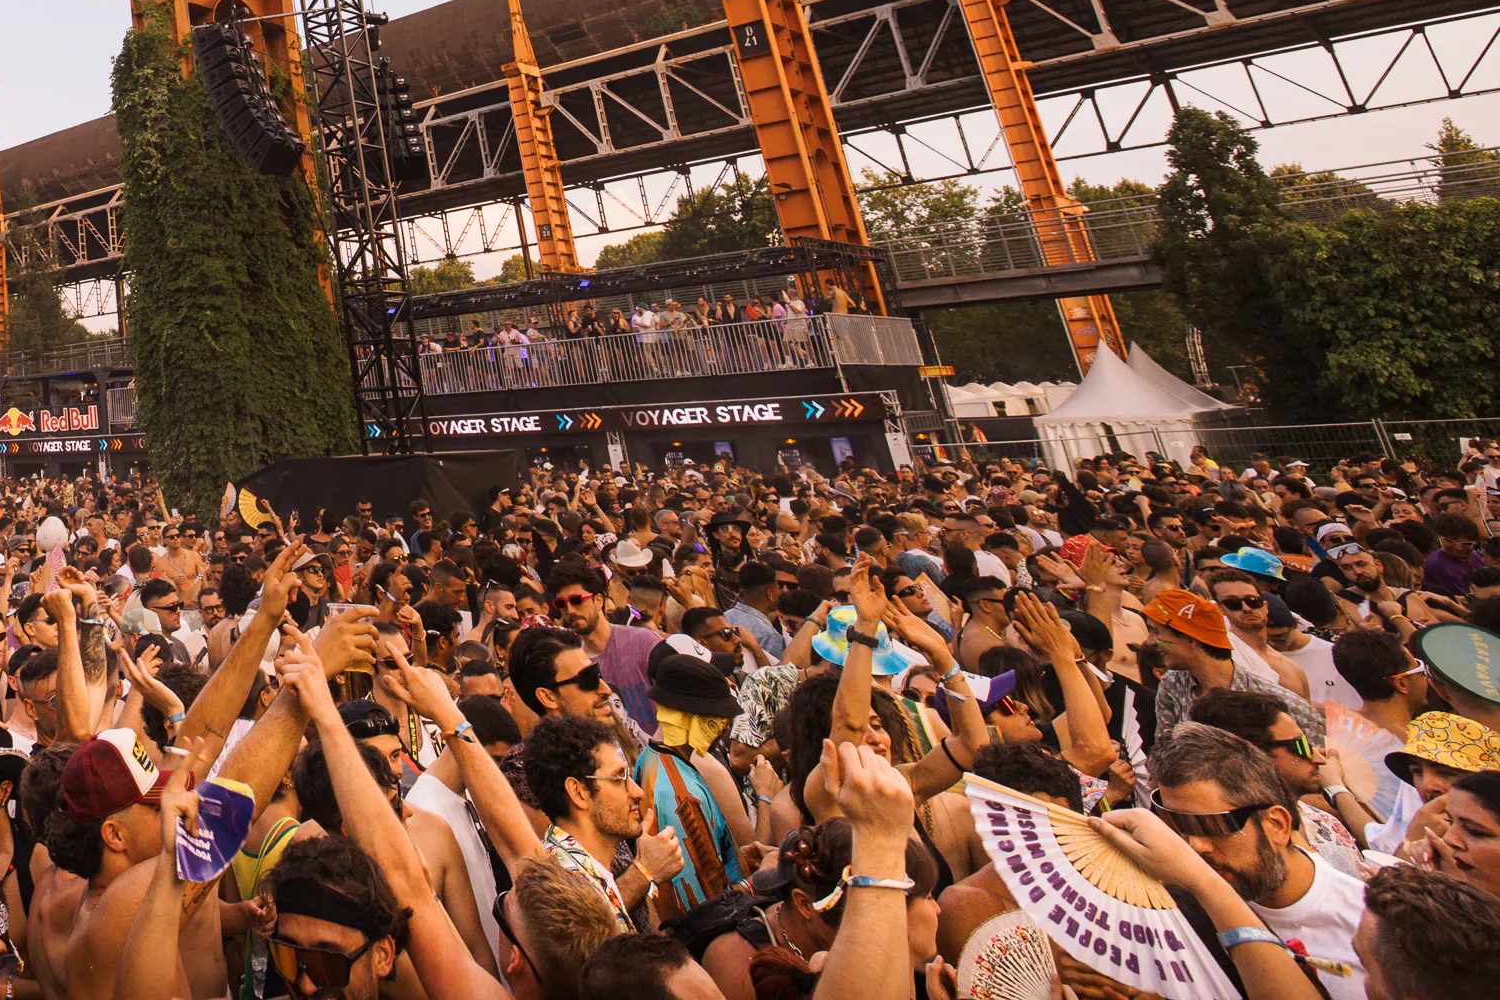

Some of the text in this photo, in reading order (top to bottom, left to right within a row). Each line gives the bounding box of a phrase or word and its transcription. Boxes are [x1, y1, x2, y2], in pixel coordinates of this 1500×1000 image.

[40, 405, 99, 432] Red Bull
[491, 416, 542, 433] STAGE
[621, 403, 783, 427] VOYAGER STAGE
[27, 439, 92, 453] VOYAGER STAGE
[985, 800, 1046, 903] DANCING
[1040, 861, 1111, 931] TECHNO
[1047, 904, 1140, 975] PEOPLE
